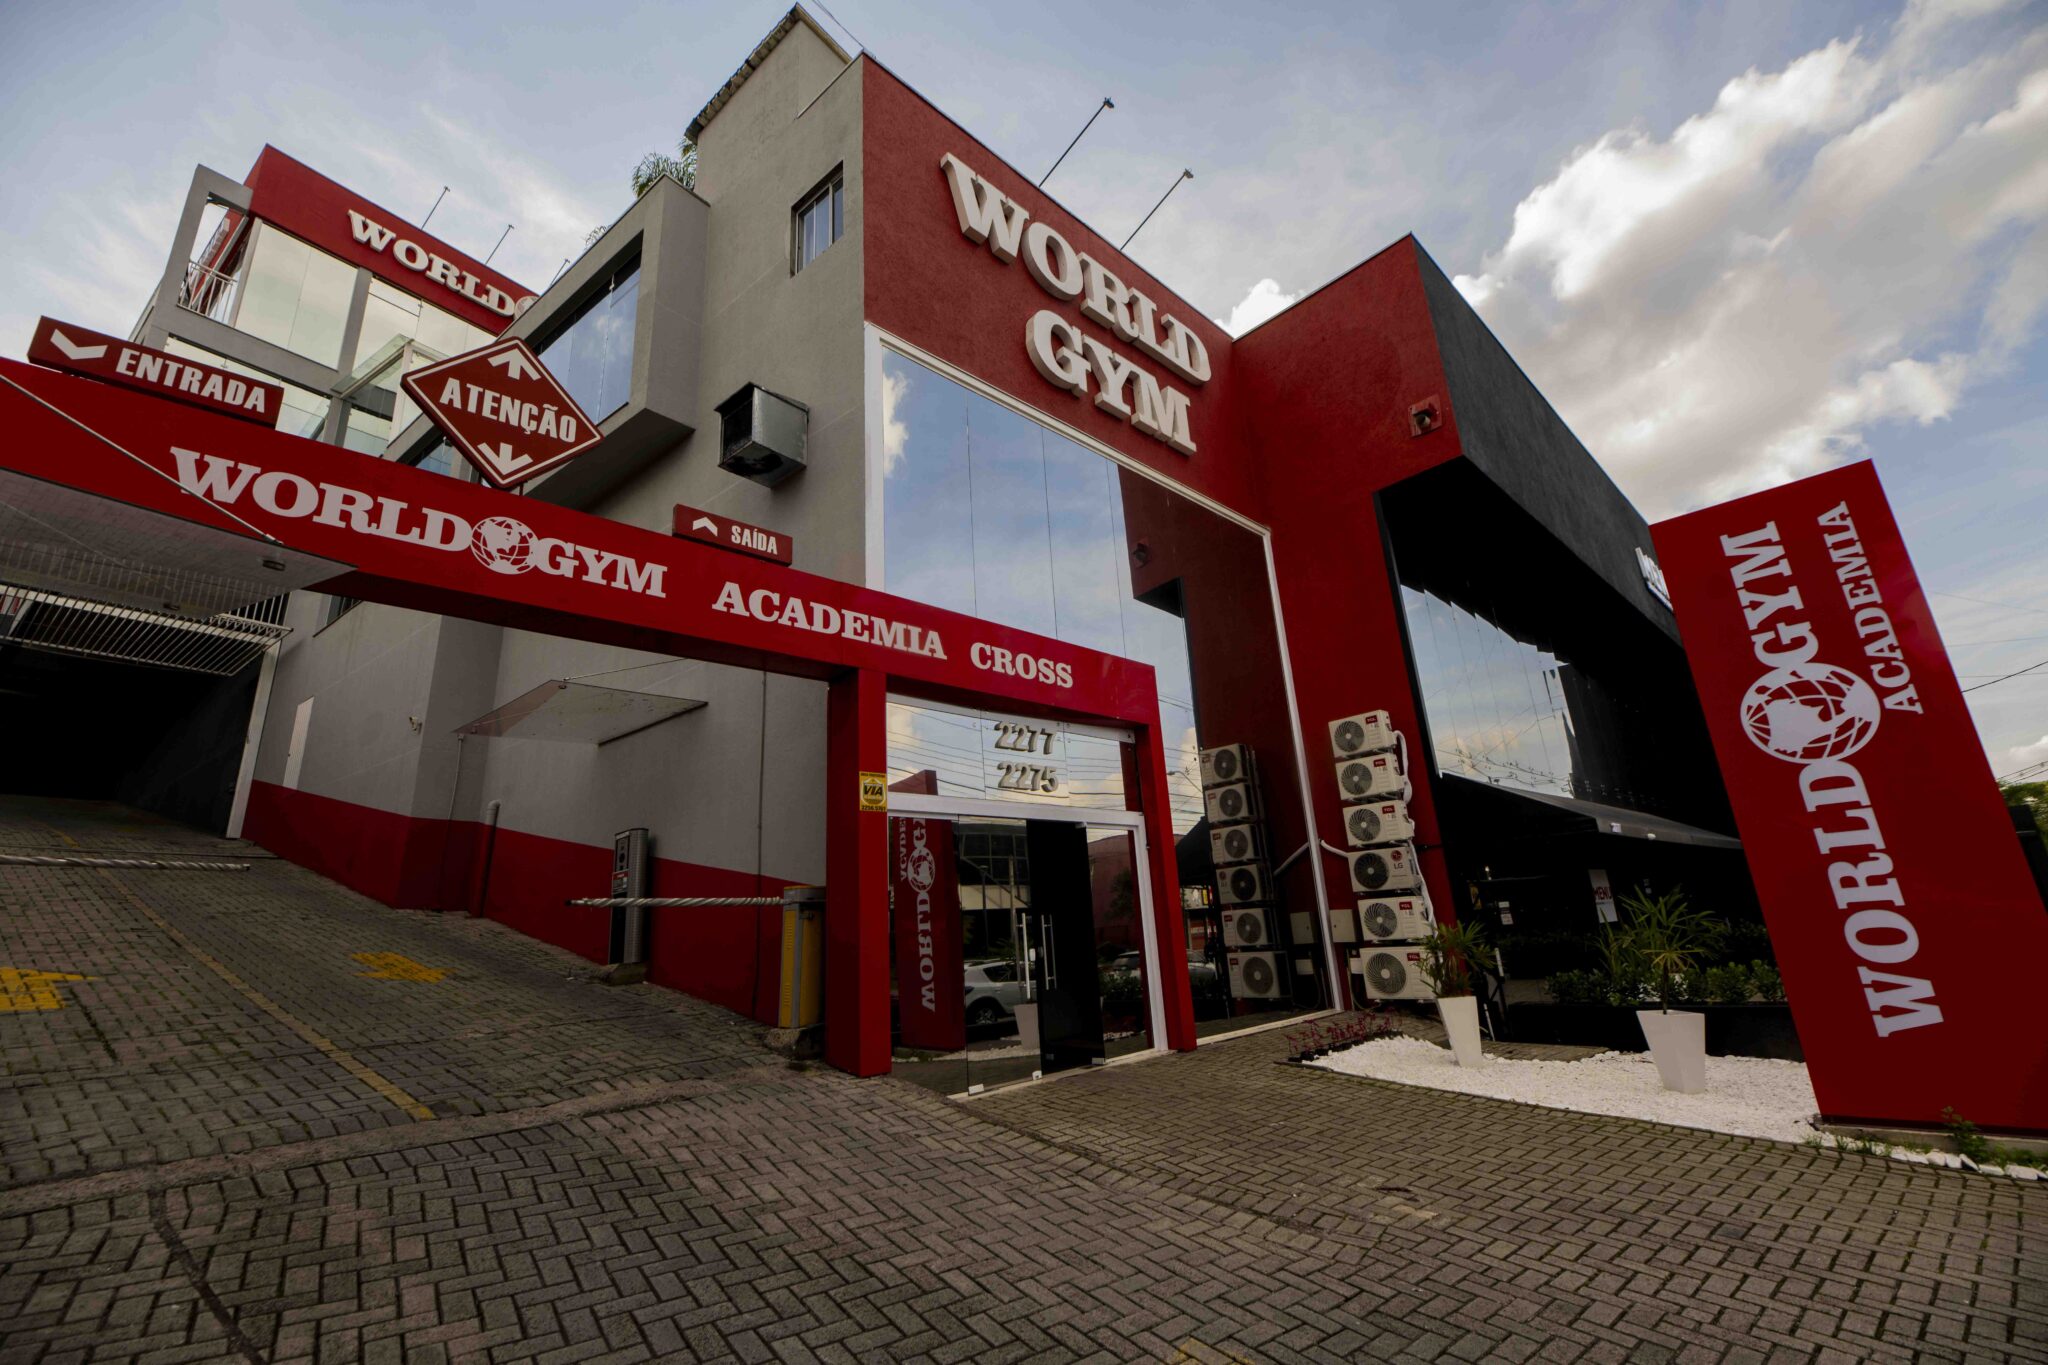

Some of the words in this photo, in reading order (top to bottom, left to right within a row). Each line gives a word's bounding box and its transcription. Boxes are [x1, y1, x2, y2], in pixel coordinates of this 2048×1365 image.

[348, 209, 516, 318] WORLD
[940, 152, 1212, 385] WORLD
[116, 348, 266, 413] ENTRADA
[440, 377, 577, 443] ATENÇÃO
[1025, 310, 1197, 455] GYM
[170, 446, 473, 553] WORLD
[531, 537, 668, 599] GYM
[712, 582, 948, 661] ACADEMIA
[970, 641, 1074, 689] CROSS
[730, 524, 779, 556] SAÍDA
[1719, 520, 1820, 670] GYM
[1817, 500, 1924, 715] ACADEMIA
[994, 721, 1057, 755] 2277
[997, 760, 1060, 793] 2275
[863, 784, 882, 796] VIA
[1393, 861, 1403, 869] LG
[1798, 760, 1944, 1038] WORLD
